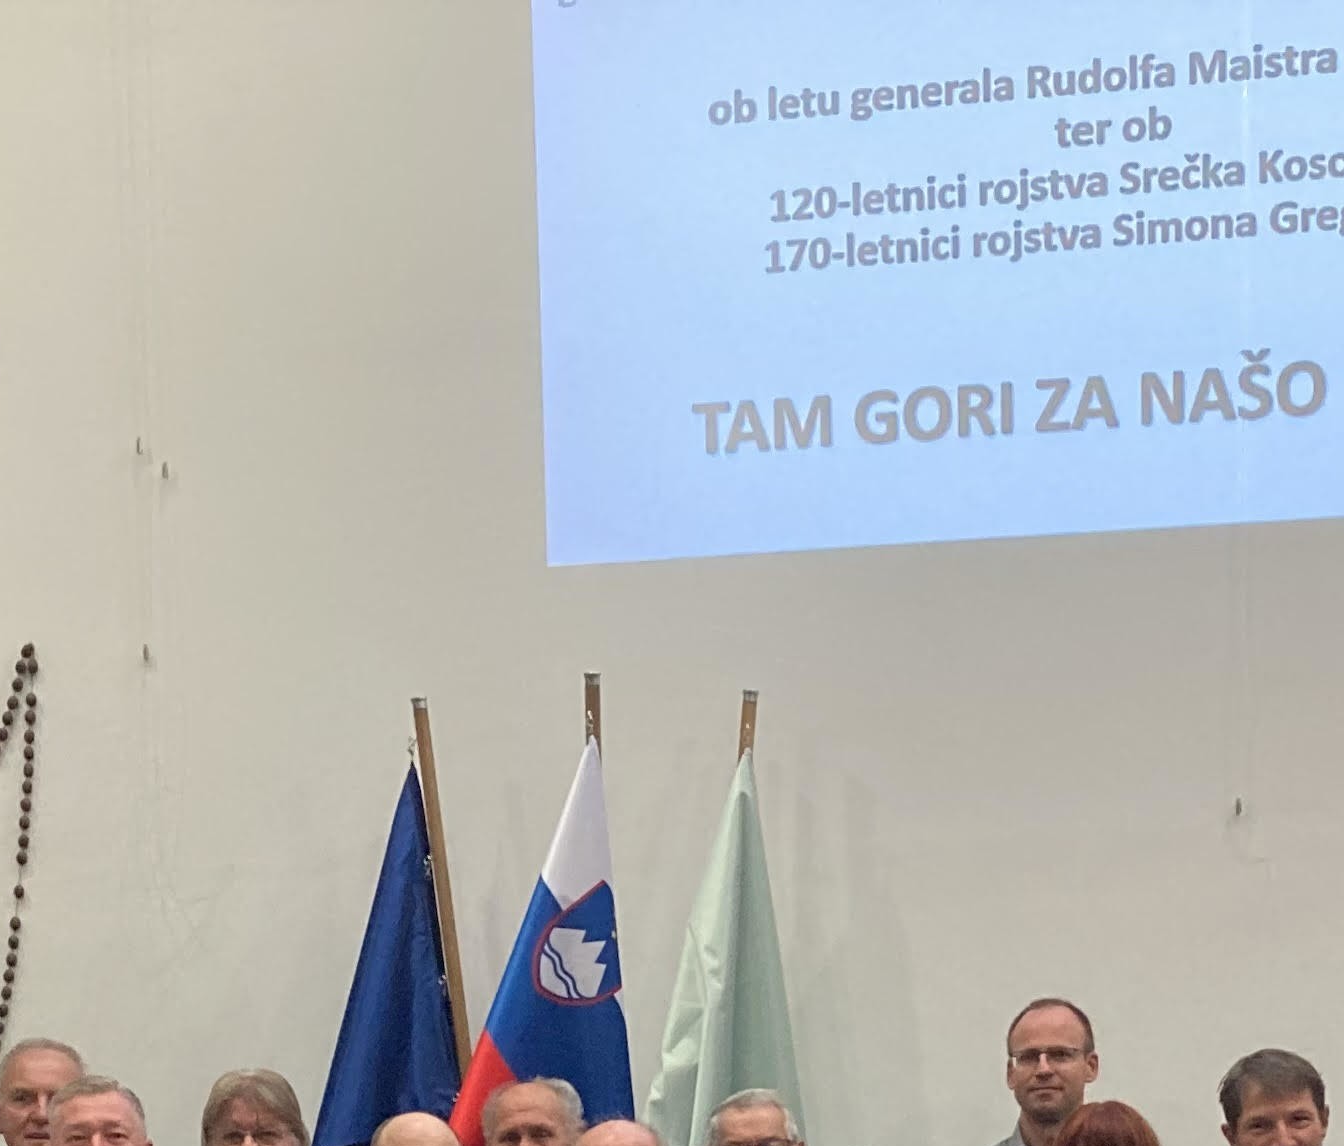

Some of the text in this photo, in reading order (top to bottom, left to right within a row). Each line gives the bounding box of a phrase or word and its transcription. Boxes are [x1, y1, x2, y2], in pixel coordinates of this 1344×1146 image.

[709, 88, 757, 125] ob
[768, 86, 840, 120] letu
[851, 68, 1014, 121] generala
[1027, 54, 1176, 99] Rudolfa
[1189, 44, 1338, 85] Maistra
[1054, 106, 1173, 148] ter ob
[770, 173, 967, 223] 120-letnici
[979, 168, 1108, 211] rojstva
[1120, 153, 1246, 194] Srečka
[765, 224, 960, 273] 170-letnici
[972, 219, 1101, 262] rojstva
[1113, 209, 1258, 246] Simona
[692, 395, 833, 455] TAM
[854, 381, 1015, 445] GORI
[1035, 376, 1119, 433] ZA
[1140, 348, 1327, 427] NAŠO
